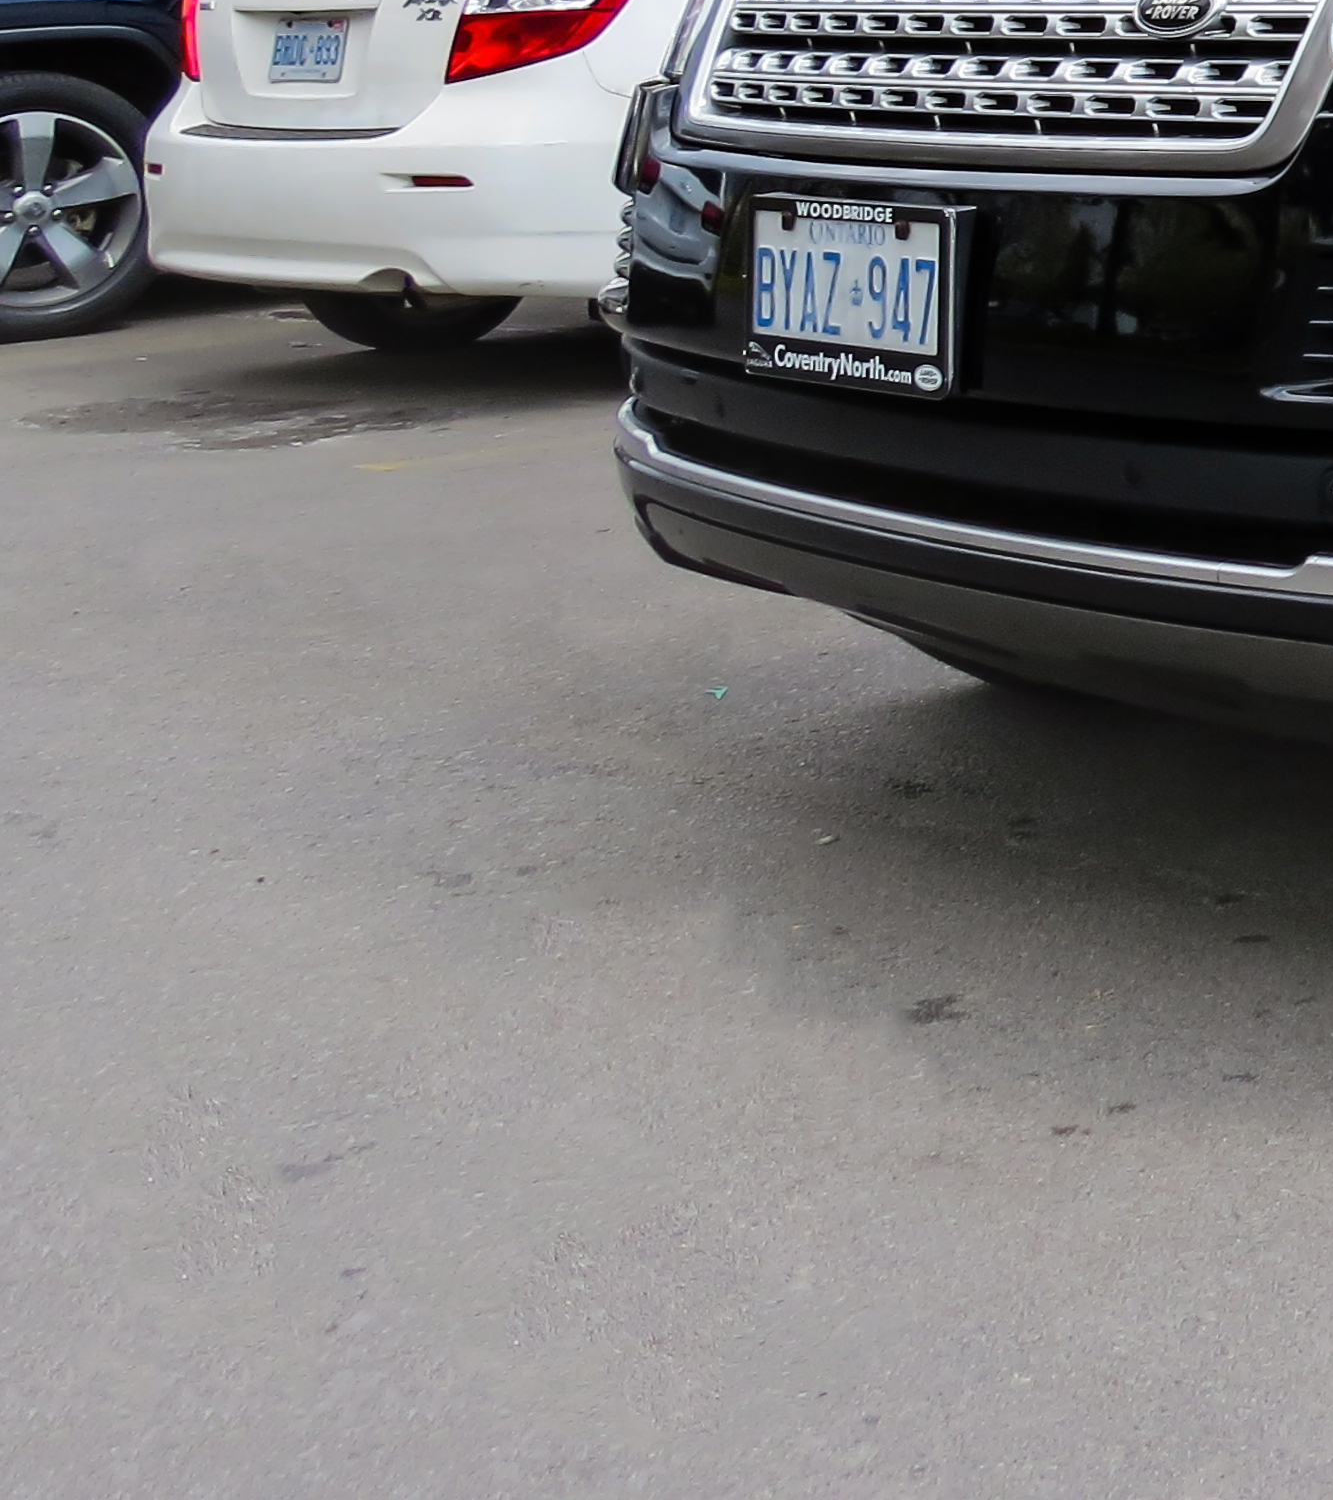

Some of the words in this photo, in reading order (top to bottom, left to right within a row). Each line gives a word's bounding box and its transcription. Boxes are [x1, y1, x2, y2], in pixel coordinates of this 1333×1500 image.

[1150, 5, 1199, 20] ROVER
[796, 201, 893, 223] WOODBRIDGE
[809, 218, 886, 247] ONTARIO
[756, 246, 841, 336] BYAZ
[867, 255, 936, 346] 947
[774, 343, 912, 386] CoventryNorth.com
